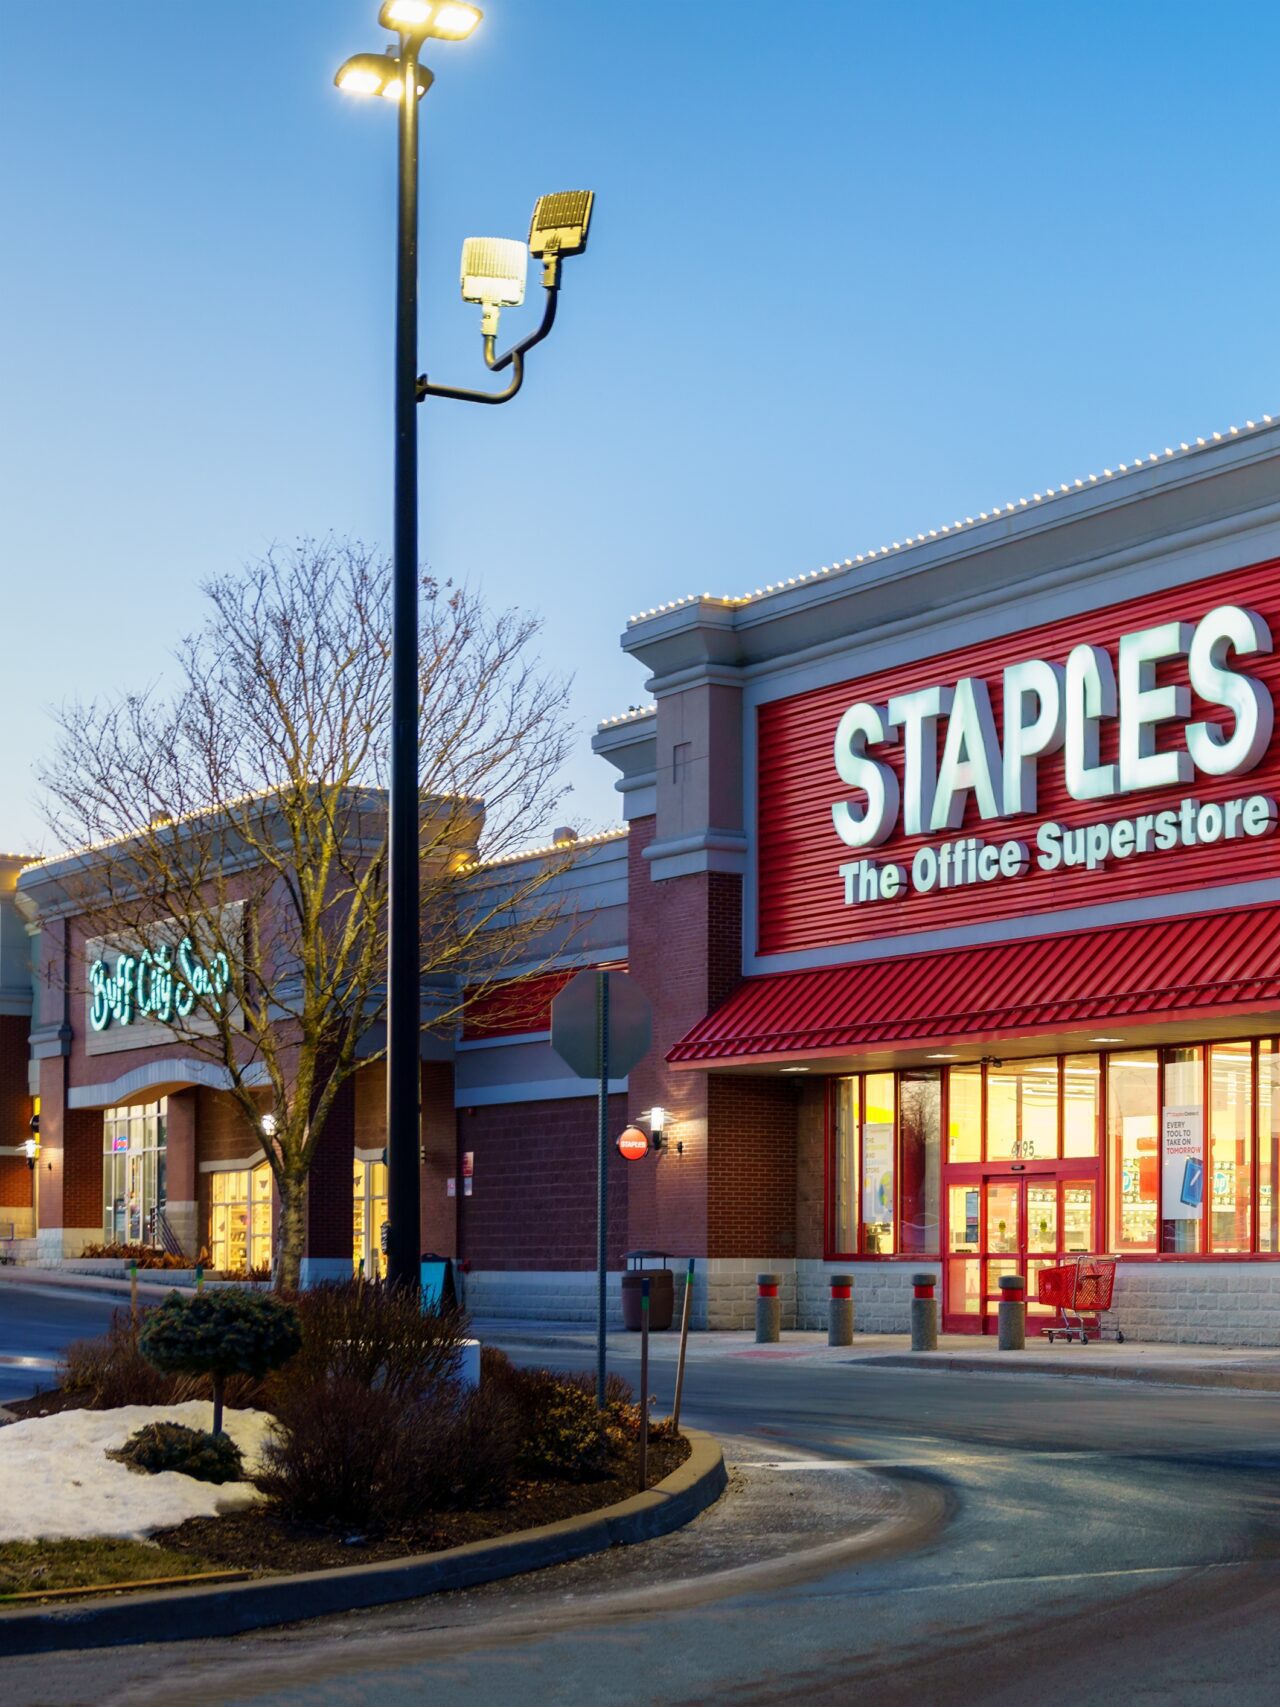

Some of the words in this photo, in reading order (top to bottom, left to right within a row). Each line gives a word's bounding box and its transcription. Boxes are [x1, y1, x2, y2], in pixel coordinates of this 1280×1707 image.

[832, 605, 1274, 848] STAPLES
[839, 859, 906, 905] The
[912, 838, 1029, 893] Office
[1037, 795, 1278, 871] Superstore
[90, 954, 135, 1031] Buff
[138, 945, 172, 1021] City
[1166, 1121, 1185, 1129] EVERY
[1183, 1129, 1191, 1137] TO
[1182, 1138, 1191, 1146] ON
[1166, 1146, 1201, 1154] TOMORROW
